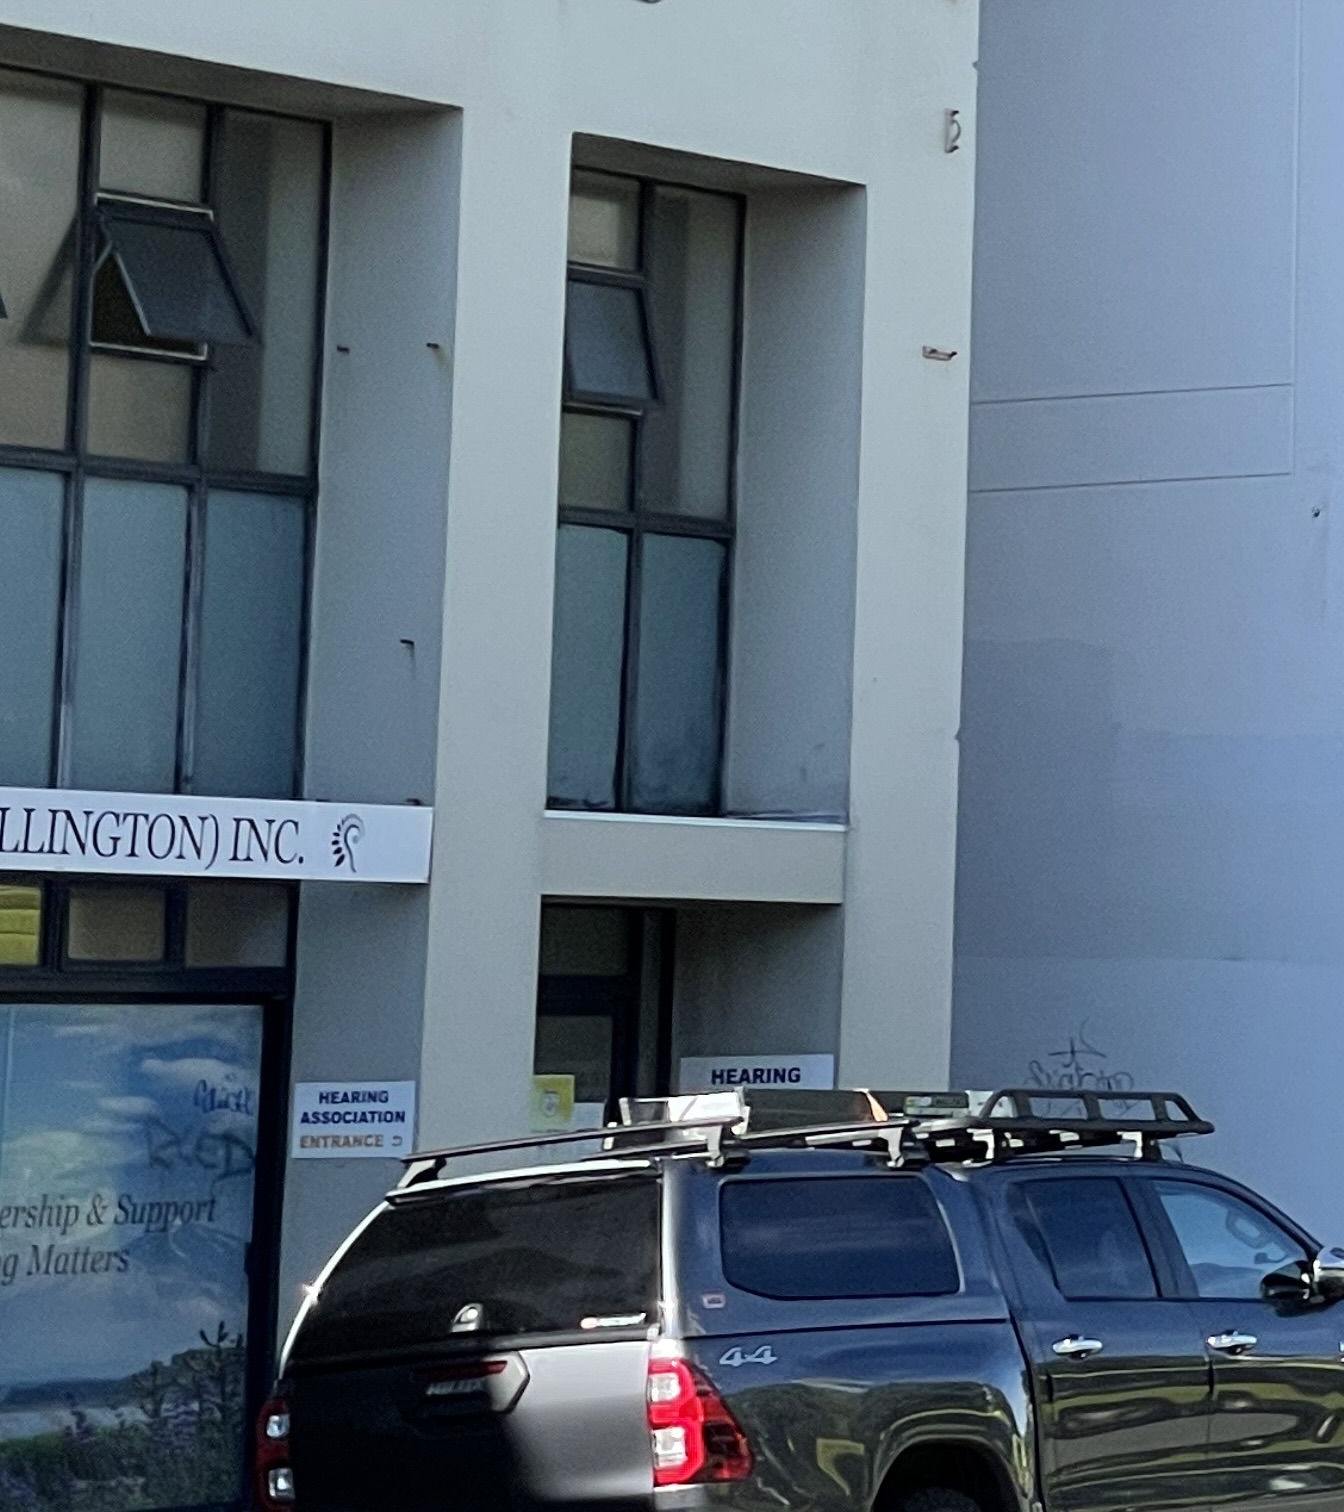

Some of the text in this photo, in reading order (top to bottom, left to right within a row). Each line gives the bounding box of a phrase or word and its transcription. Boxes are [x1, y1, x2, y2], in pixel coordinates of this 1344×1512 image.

[229, 817, 304, 864] INC.
[711, 1067, 801, 1085] HEARING
[318, 1090, 389, 1104] HEARING
[301, 1110, 405, 1124] ASSOCIATION
[301, 1134, 384, 1148] ENTRANCE
[0, 1193, 216, 1235] ership & Support
[27, 1244, 130, 1276] Matters
